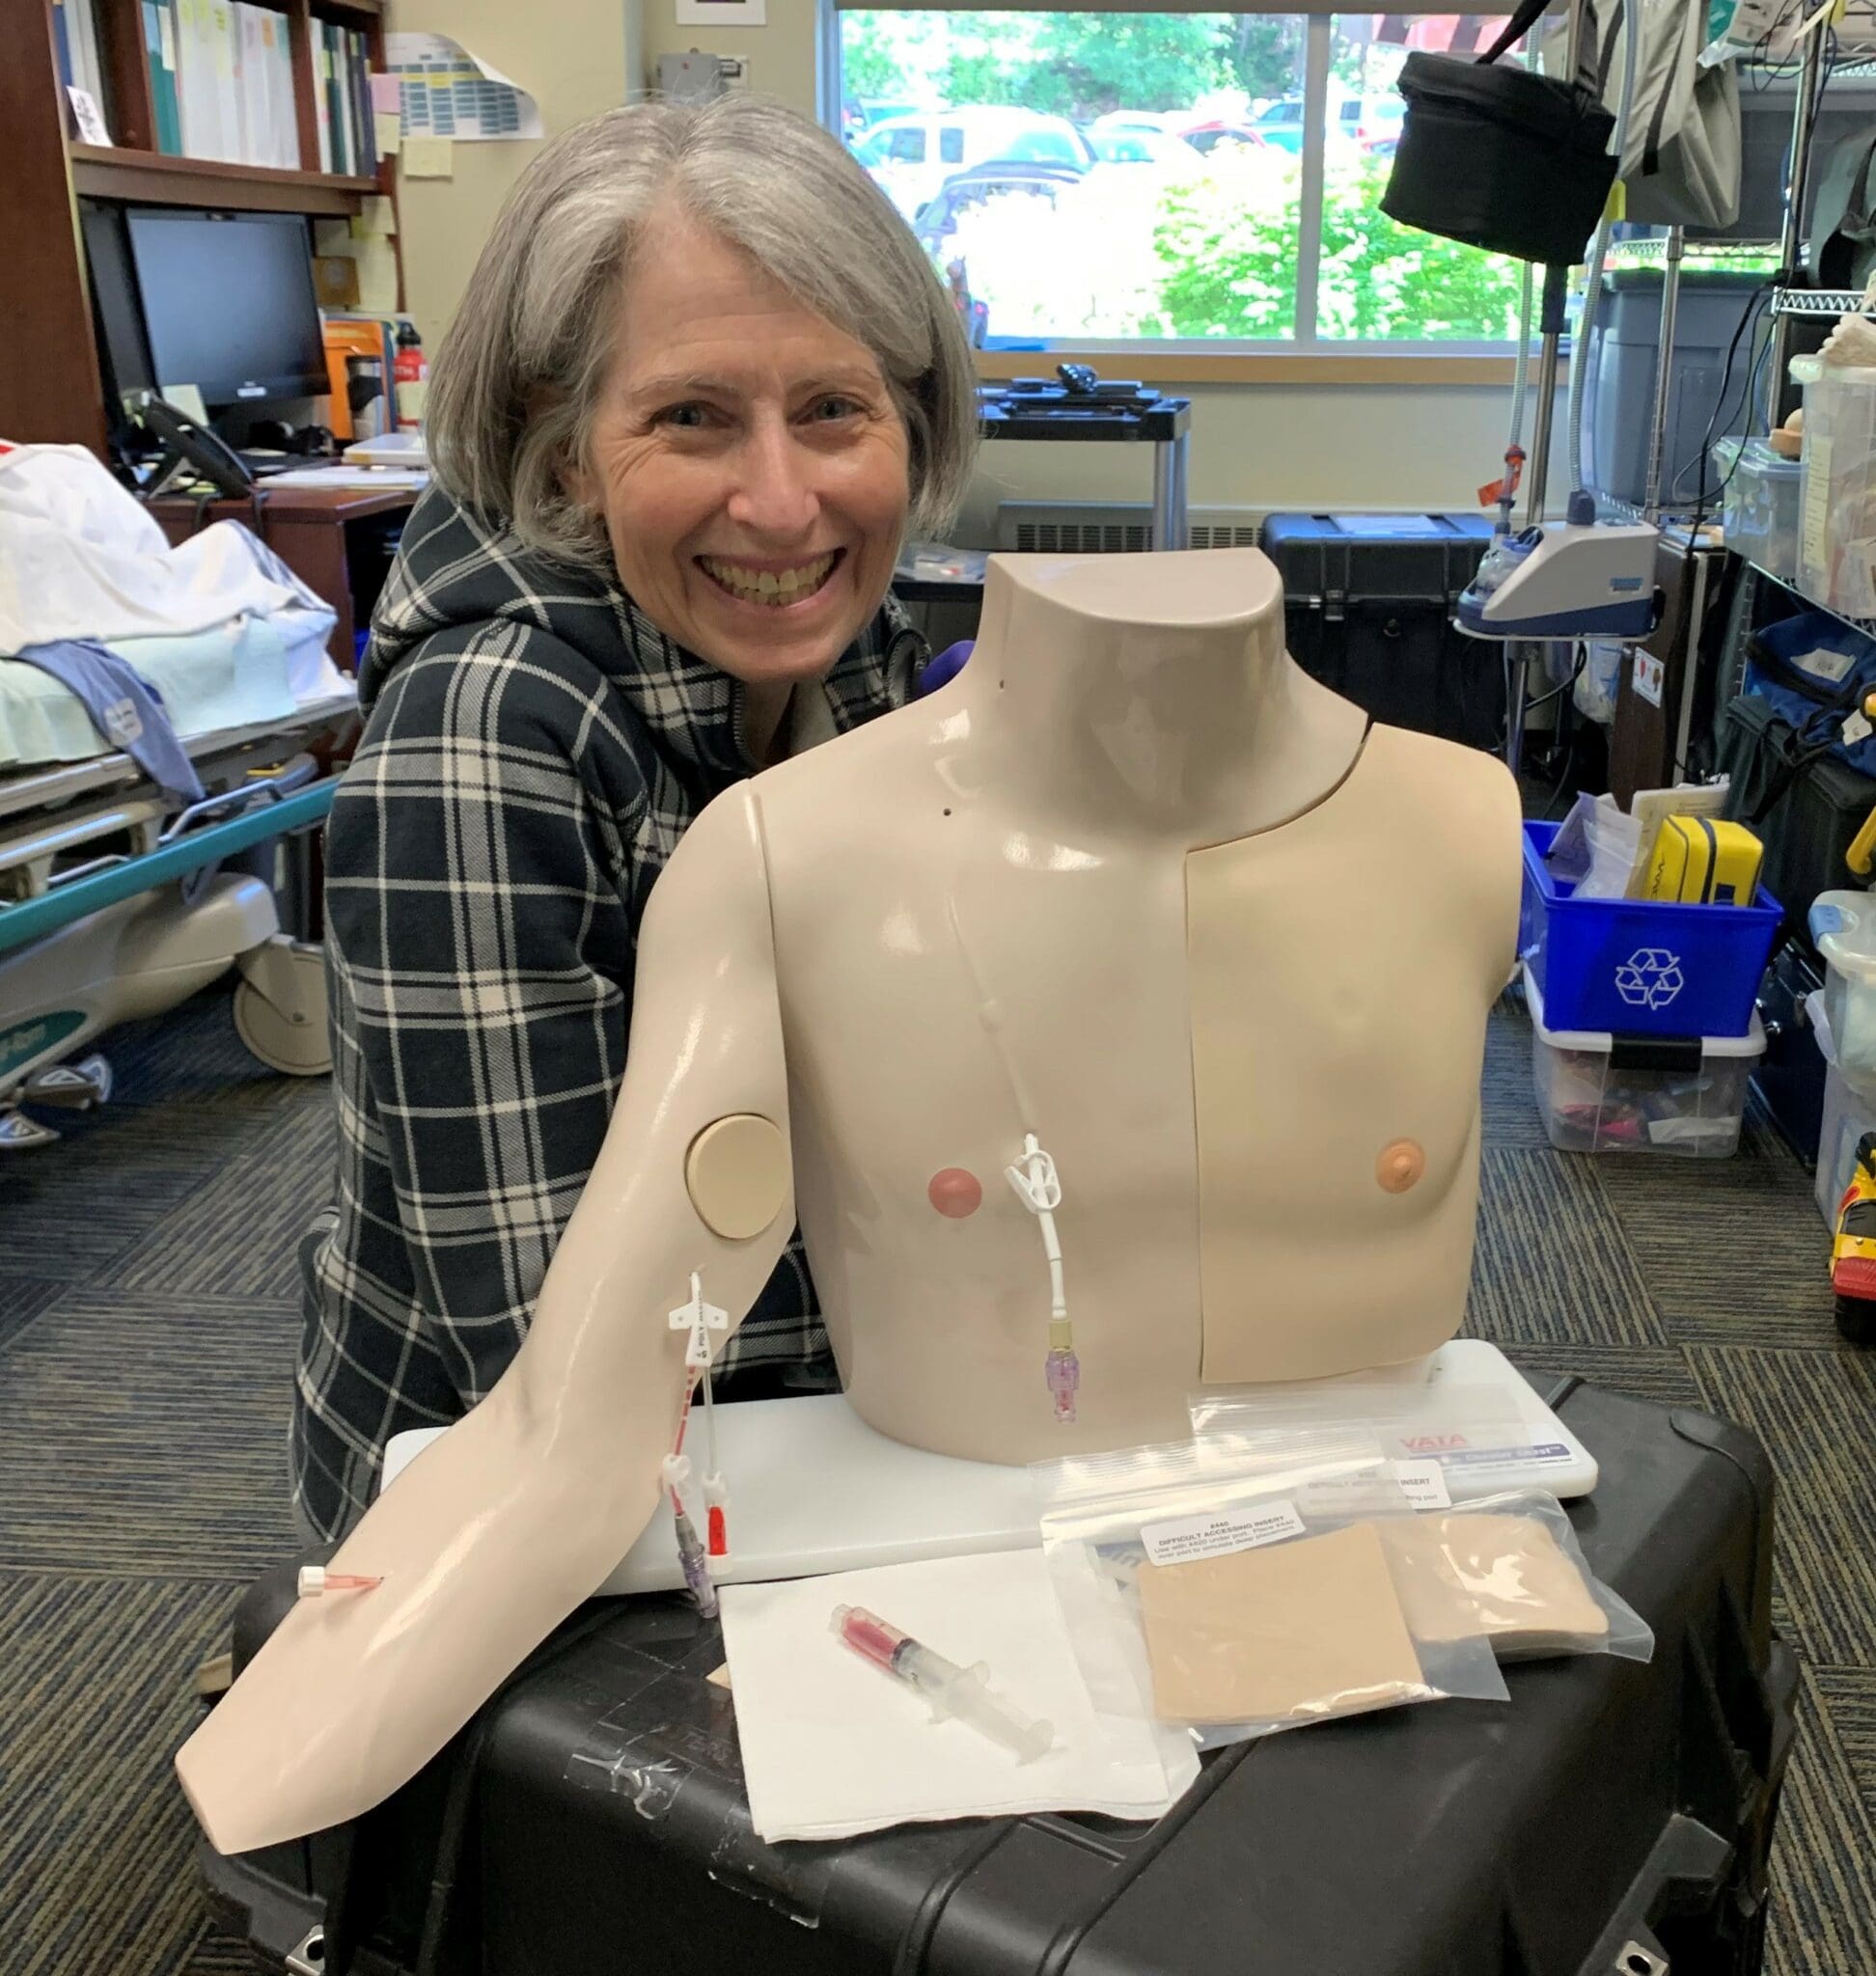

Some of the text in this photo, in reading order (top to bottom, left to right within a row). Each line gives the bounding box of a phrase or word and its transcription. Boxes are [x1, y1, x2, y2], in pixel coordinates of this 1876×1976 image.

[1159, 1516, 1284, 1545] DIFFICULT ACCESSING INSERT
